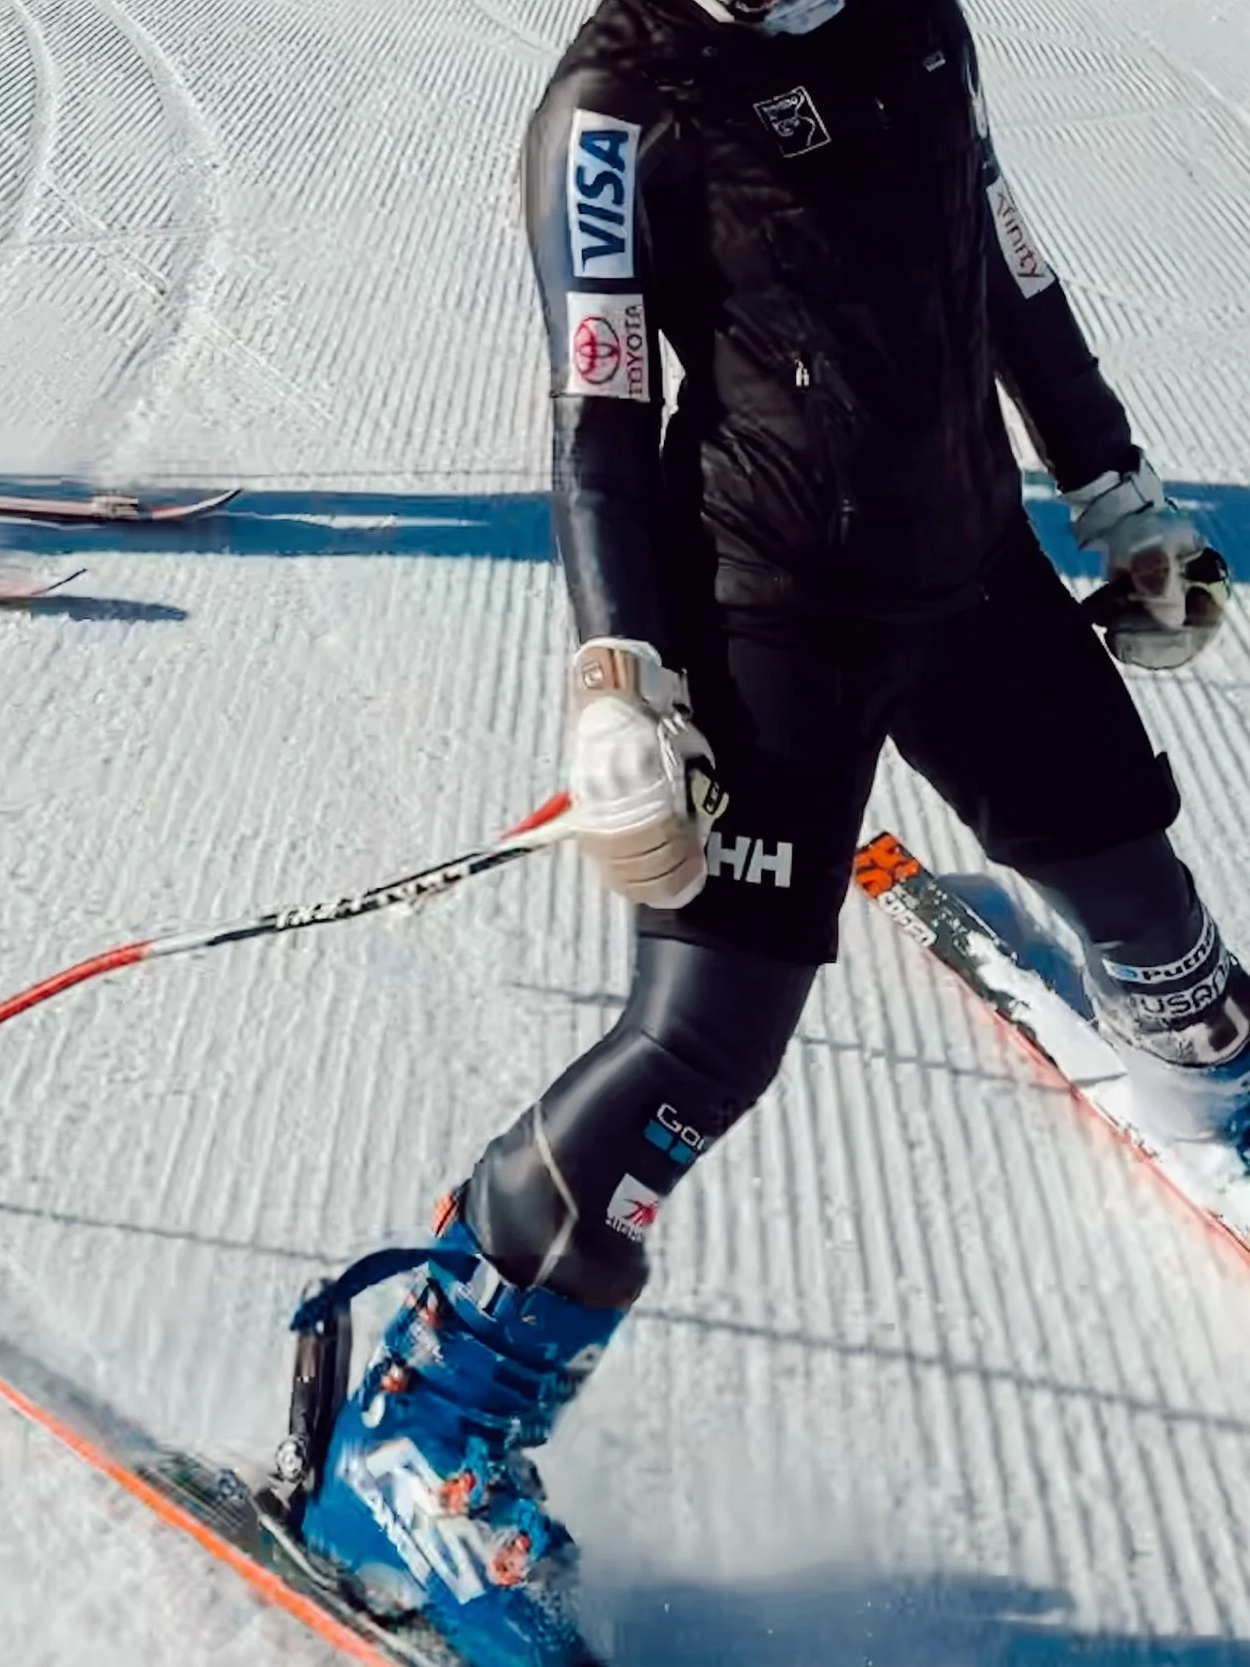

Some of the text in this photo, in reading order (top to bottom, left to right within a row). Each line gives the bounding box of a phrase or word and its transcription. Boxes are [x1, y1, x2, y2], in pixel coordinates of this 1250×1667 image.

[576, 130, 629, 272] VISA
[625, 304, 644, 398] TOYOTA
[707, 831, 793, 888] HH
